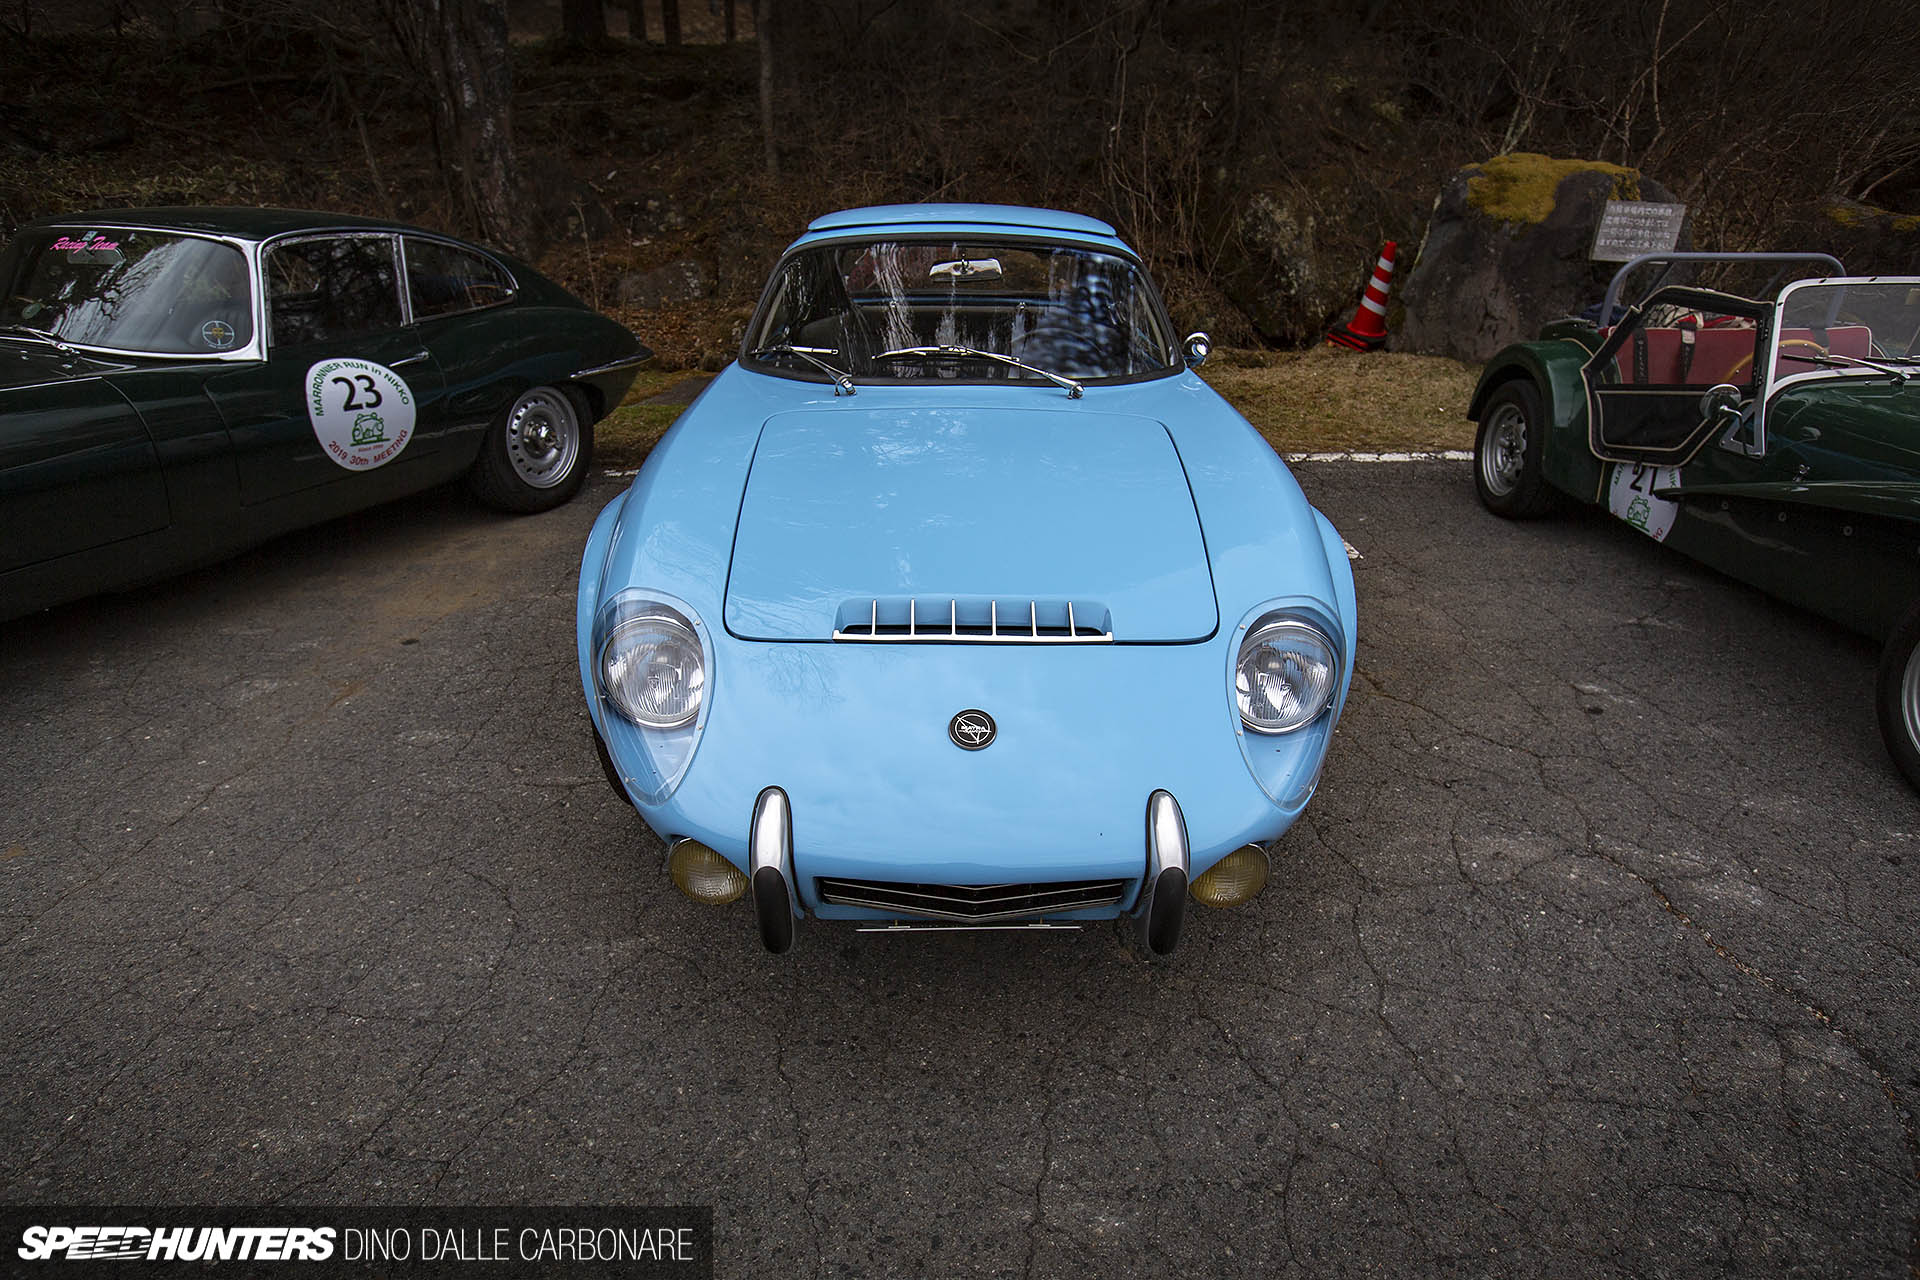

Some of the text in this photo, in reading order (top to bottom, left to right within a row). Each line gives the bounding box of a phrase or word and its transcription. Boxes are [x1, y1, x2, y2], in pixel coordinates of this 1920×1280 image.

[49, 236, 88, 254] Racing
[312, 361, 409, 416] MARRONNIER RUN in NIKKO
[331, 374, 383, 412] 23
[328, 440, 348, 460] 2019
[349, 455, 369, 466] 30th
[373, 429, 409, 463] MEETING
